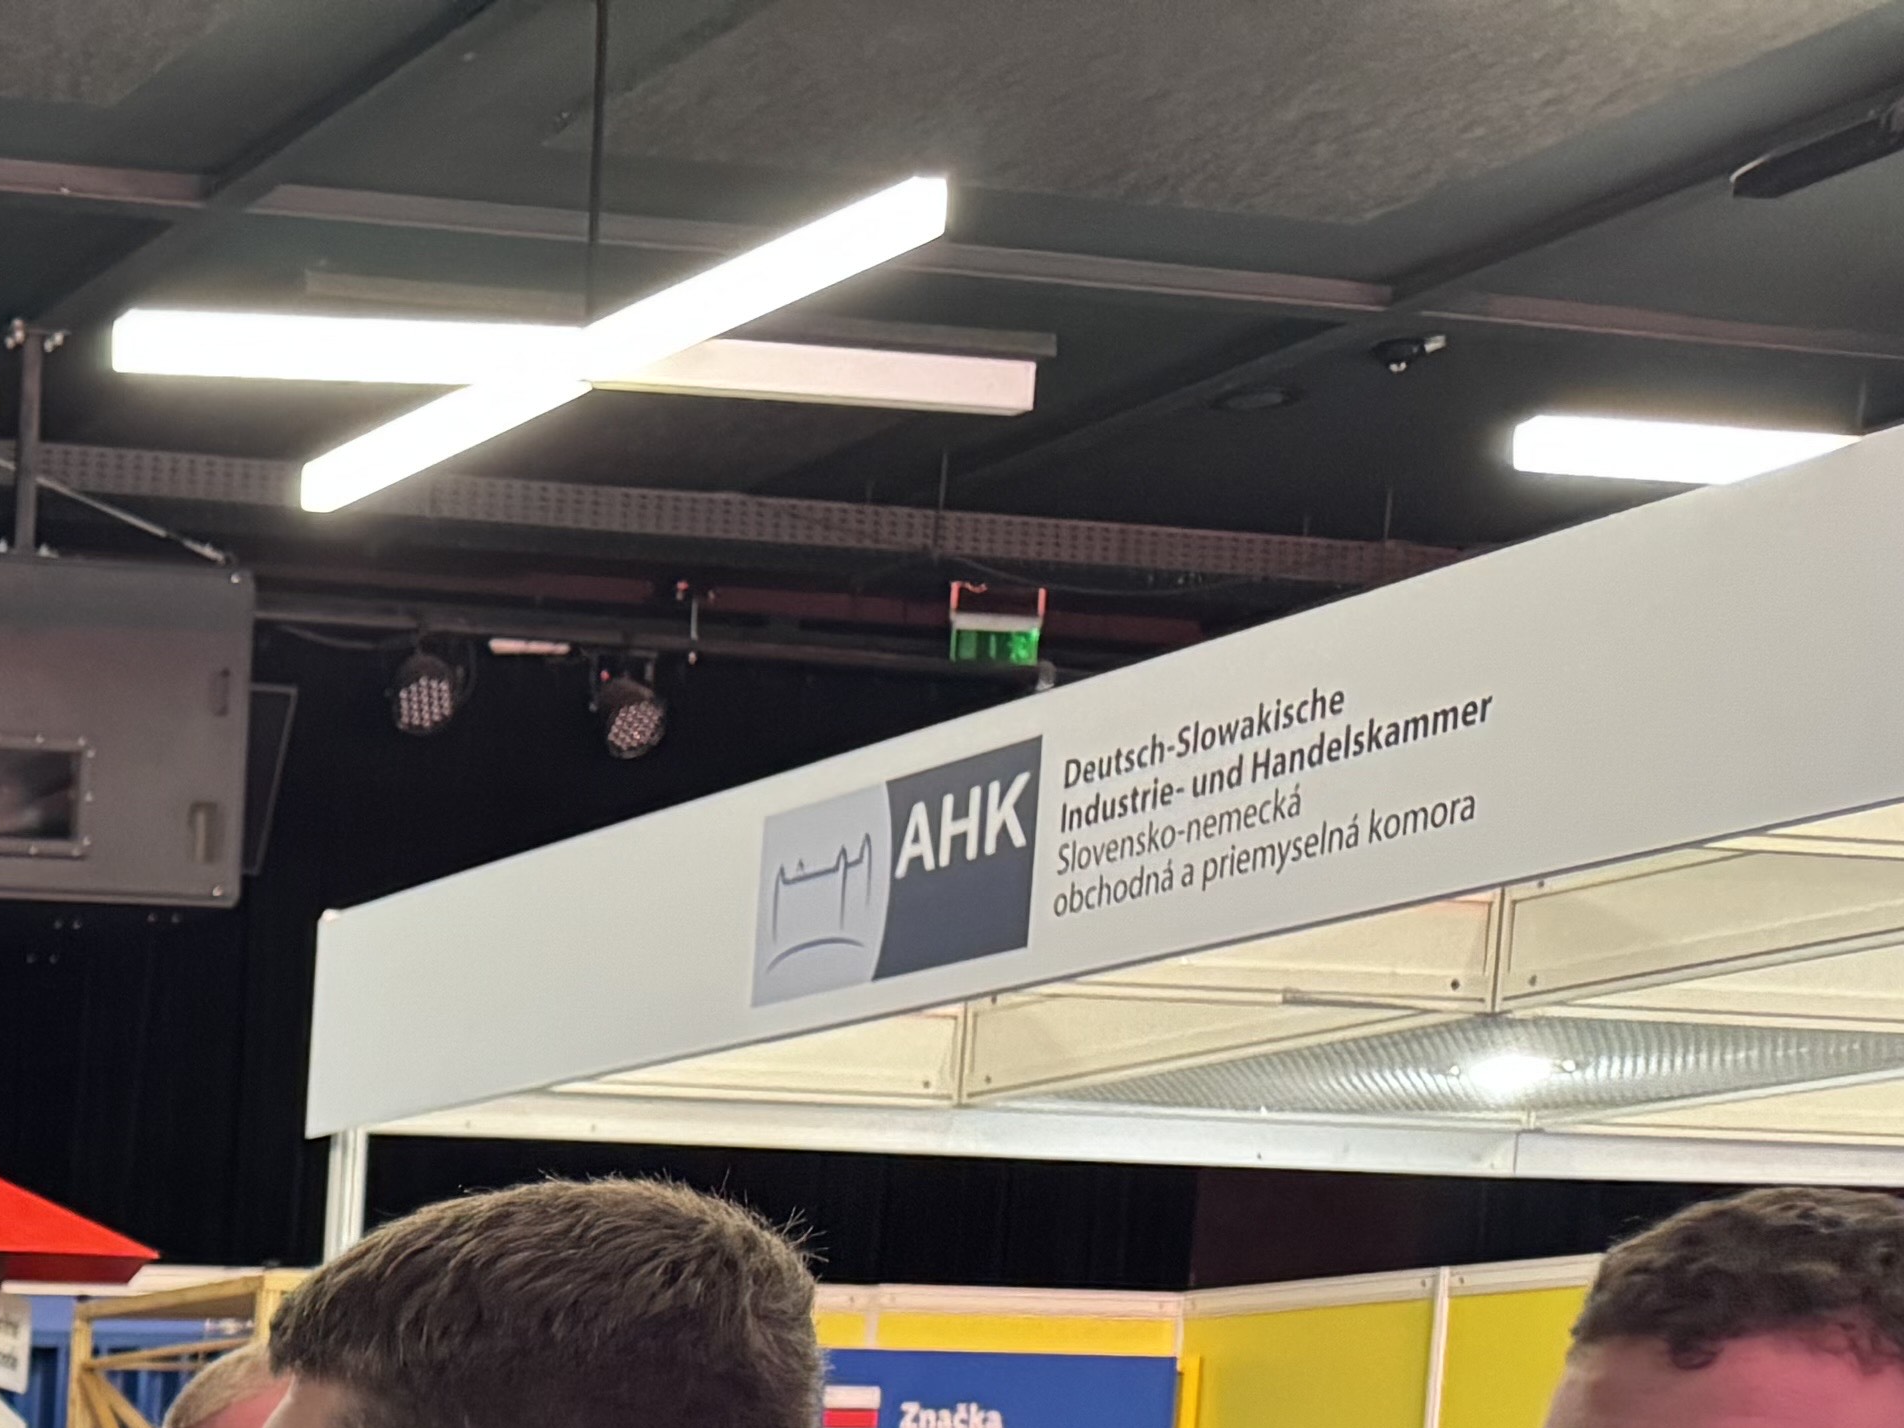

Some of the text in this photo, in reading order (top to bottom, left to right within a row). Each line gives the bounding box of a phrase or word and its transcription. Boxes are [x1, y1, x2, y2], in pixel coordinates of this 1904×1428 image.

[1059, 692, 1494, 833] Industrie- und Handelskammer
[1063, 686, 1346, 789] Deutsch-Slowakische
[894, 771, 1034, 879] AHK
[1052, 794, 1477, 918] obchodná a priemyselná komora
[1055, 783, 1302, 876] Slovensko-nemecká
